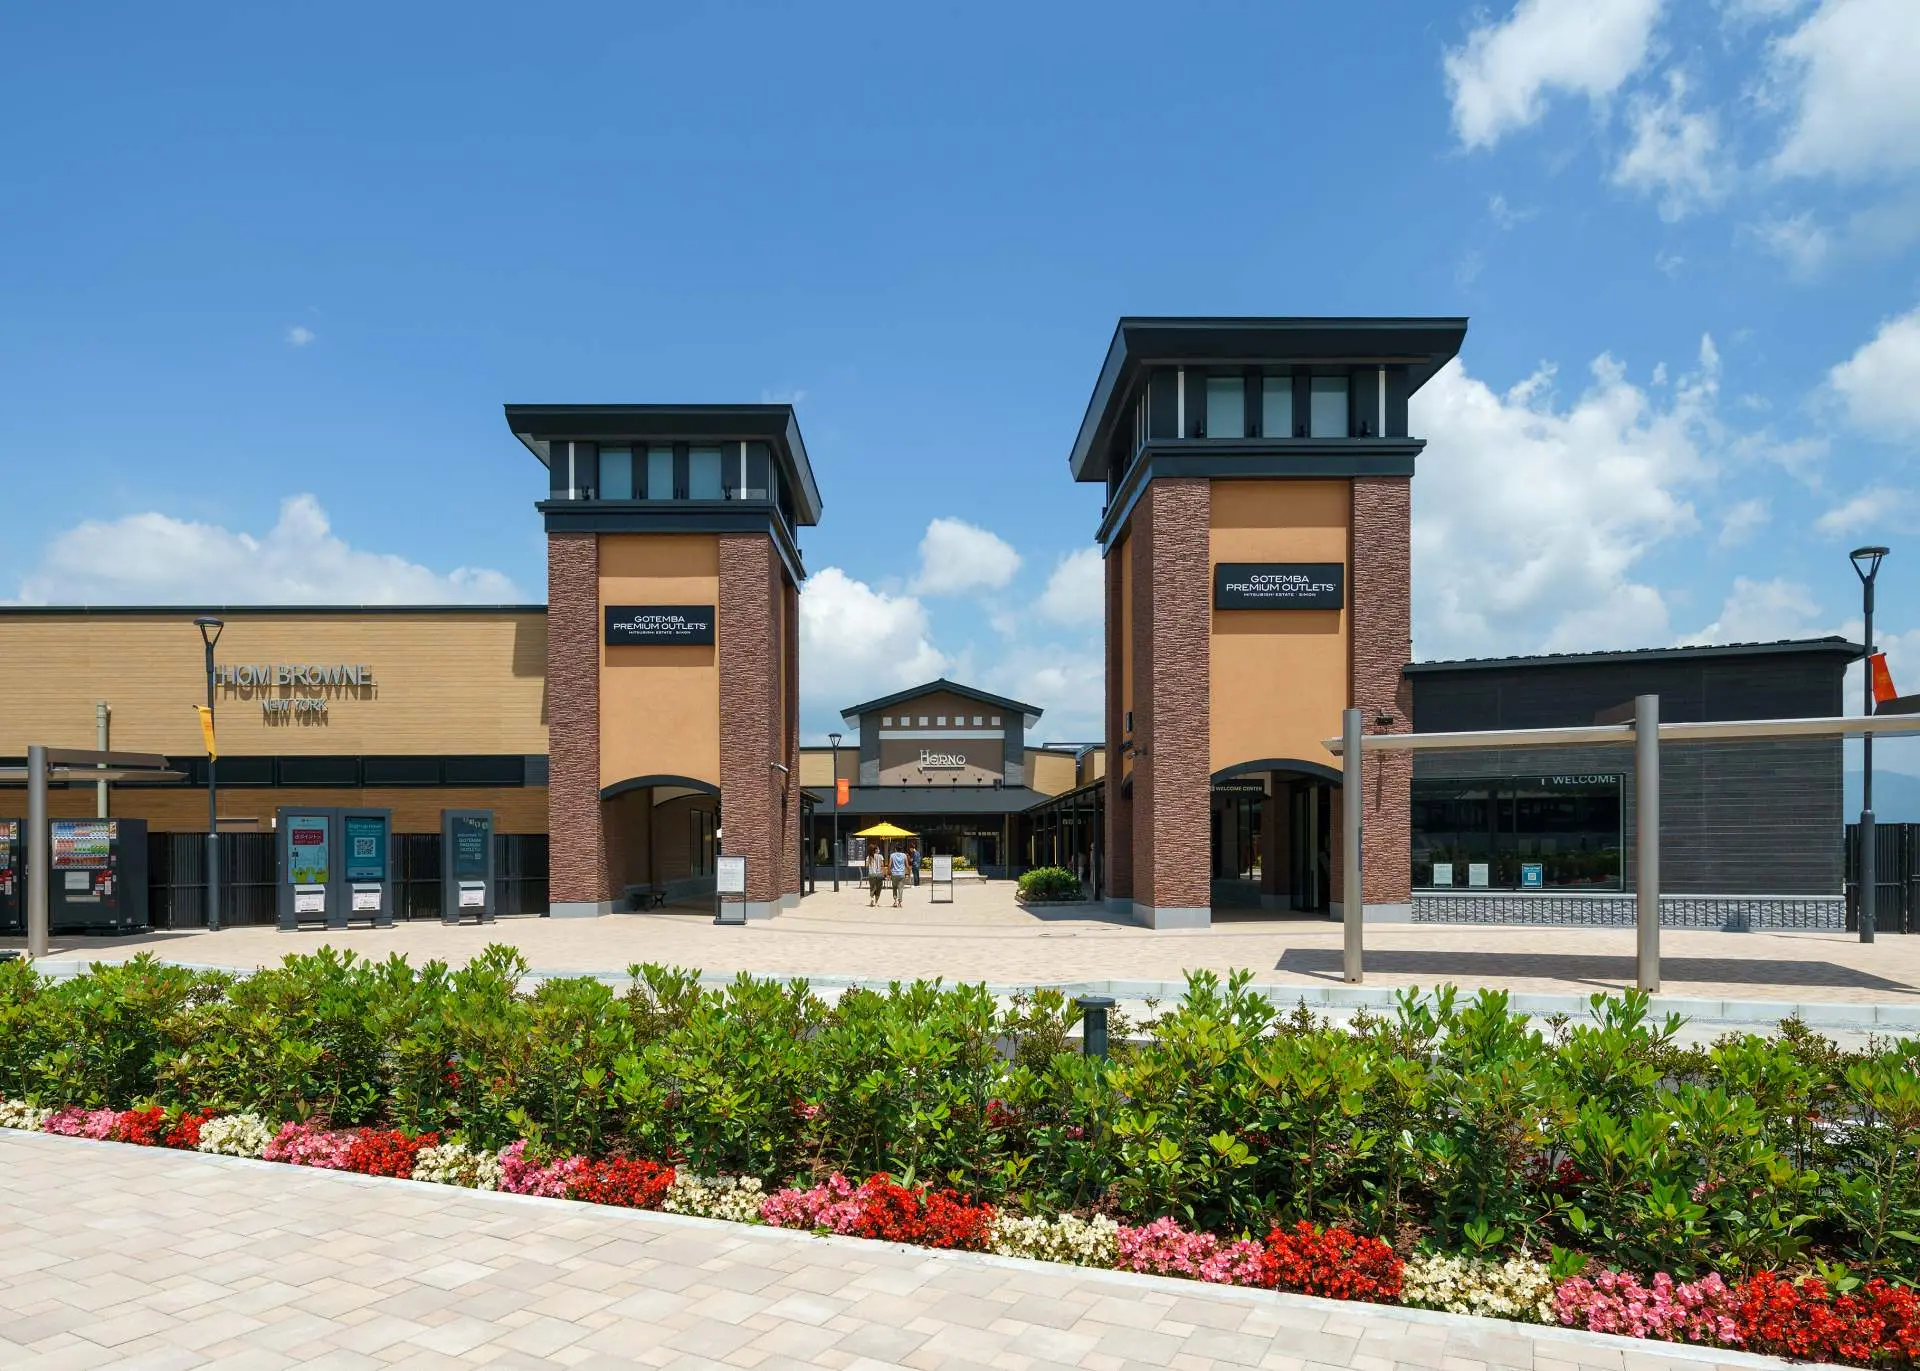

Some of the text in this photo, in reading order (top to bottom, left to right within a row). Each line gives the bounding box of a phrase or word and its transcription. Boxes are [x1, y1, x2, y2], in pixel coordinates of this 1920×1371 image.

[1250, 575, 1310, 583] GOTEMBA
[1226, 583, 1334, 592] PREMIUM OUTLETS
[634, 615, 686, 623] GOTEMBA
[262, 698, 328, 711] NEW YORK
[920, 749, 966, 766] HERNO
[1552, 775, 1616, 784] WELCOME
